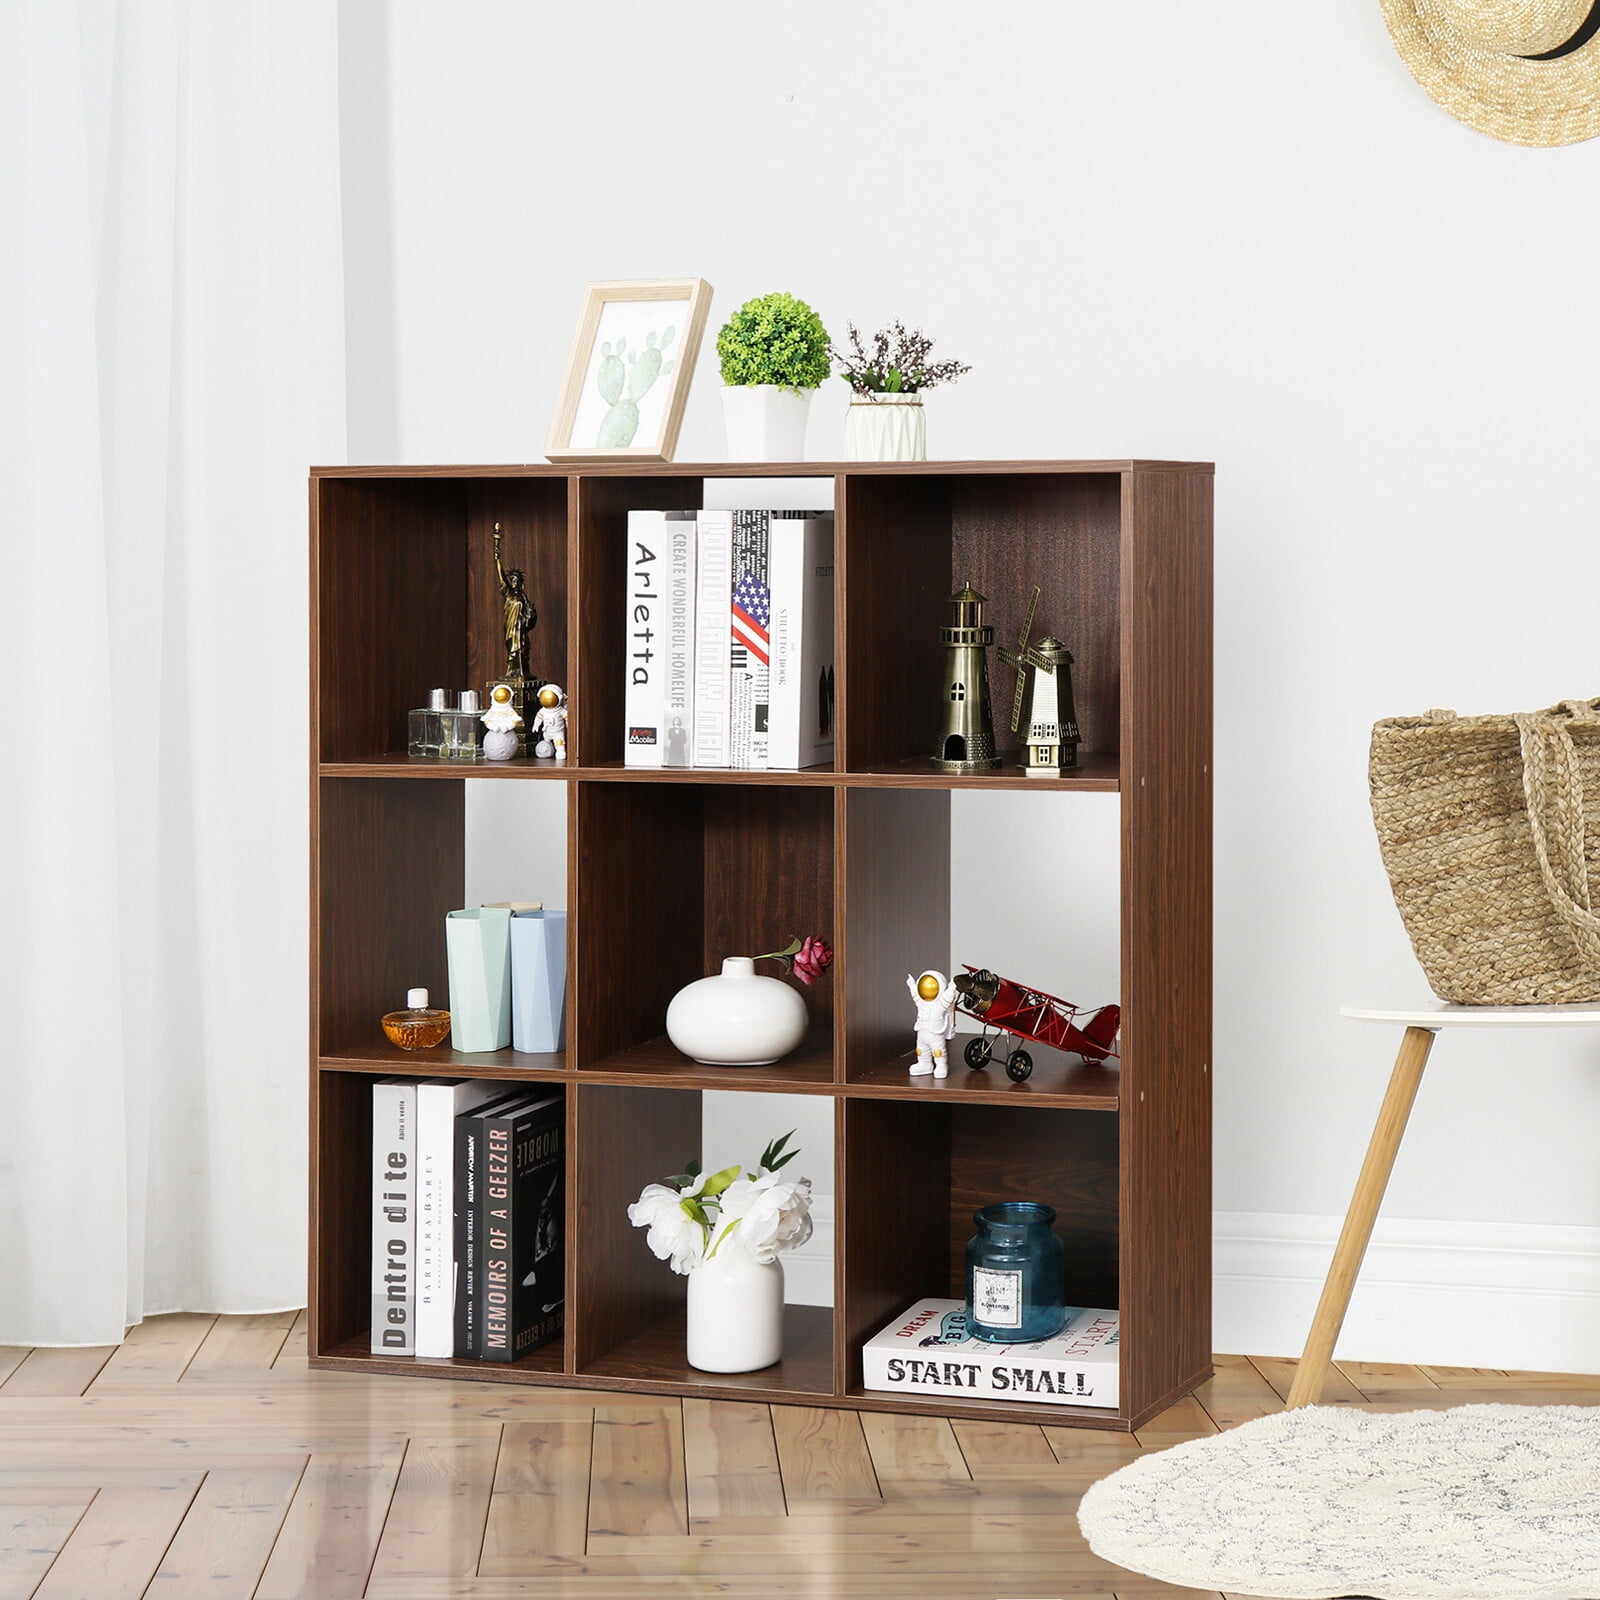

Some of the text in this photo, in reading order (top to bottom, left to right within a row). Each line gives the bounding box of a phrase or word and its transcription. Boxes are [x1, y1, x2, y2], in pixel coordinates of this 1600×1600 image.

[632, 542, 658, 686] Arletta
[671, 534, 687, 708] CREATE WONDERFUL HOMELIFE
[778, 608, 787, 685] STILETTO BOOK
[382, 1152, 407, 1348] Dentro di te
[488, 1128, 508, 1349] MEMOIRS OF A GEEZER
[896, 1309, 940, 1338] DREAM
[944, 1314, 966, 1341] BIG
[1065, 1318, 1118, 1356] START
[887, 1358, 1095, 1396] START SMALL
